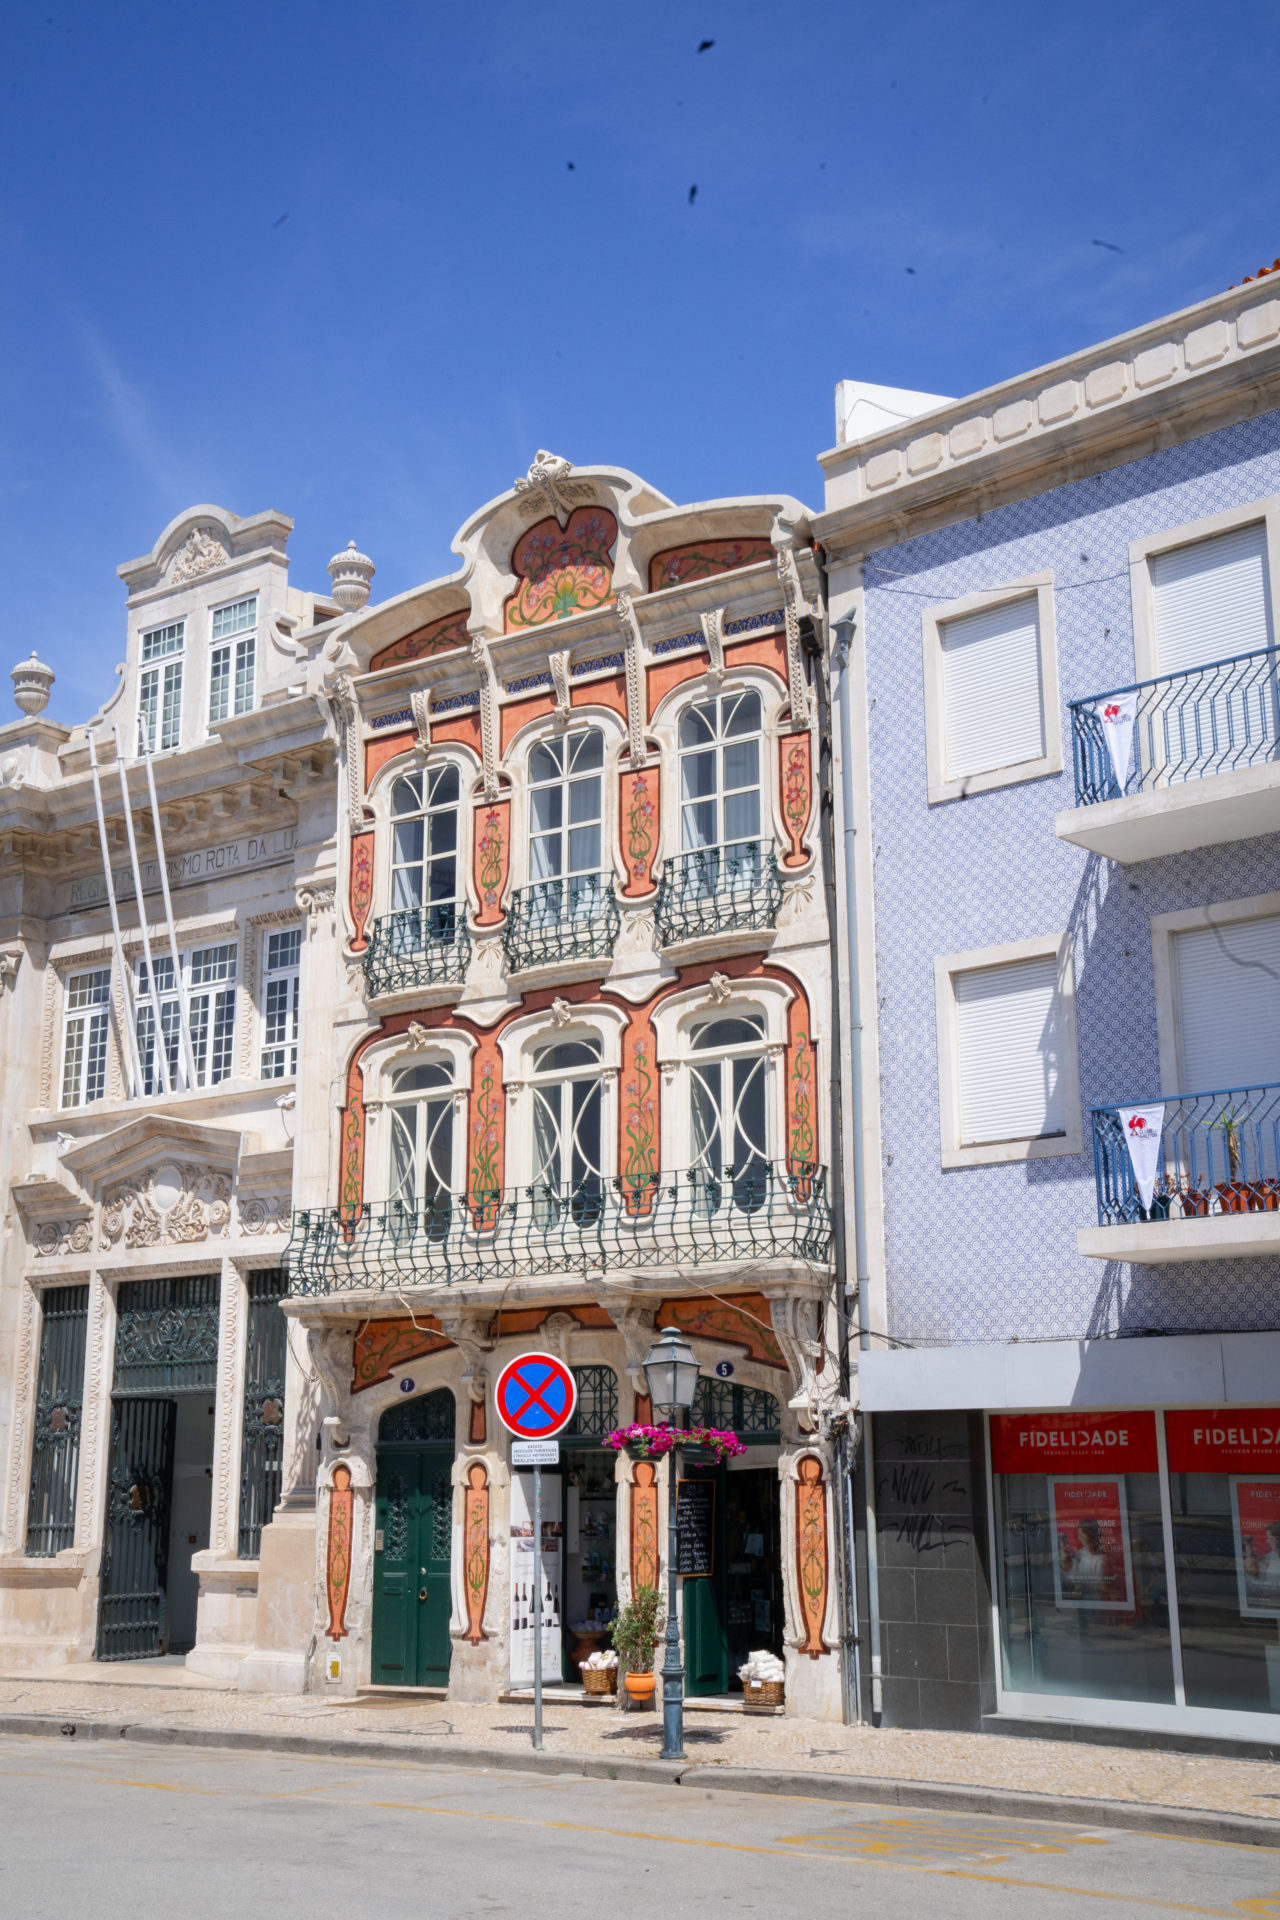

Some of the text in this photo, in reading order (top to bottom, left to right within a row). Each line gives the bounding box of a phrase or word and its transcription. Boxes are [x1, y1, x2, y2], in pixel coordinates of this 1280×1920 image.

[206, 844, 241, 871] ROTA
[247, 838, 267, 860] DA
[721, 1363, 727, 1376] 5
[1019, 1430, 1129, 1447] FIDELIDADE
